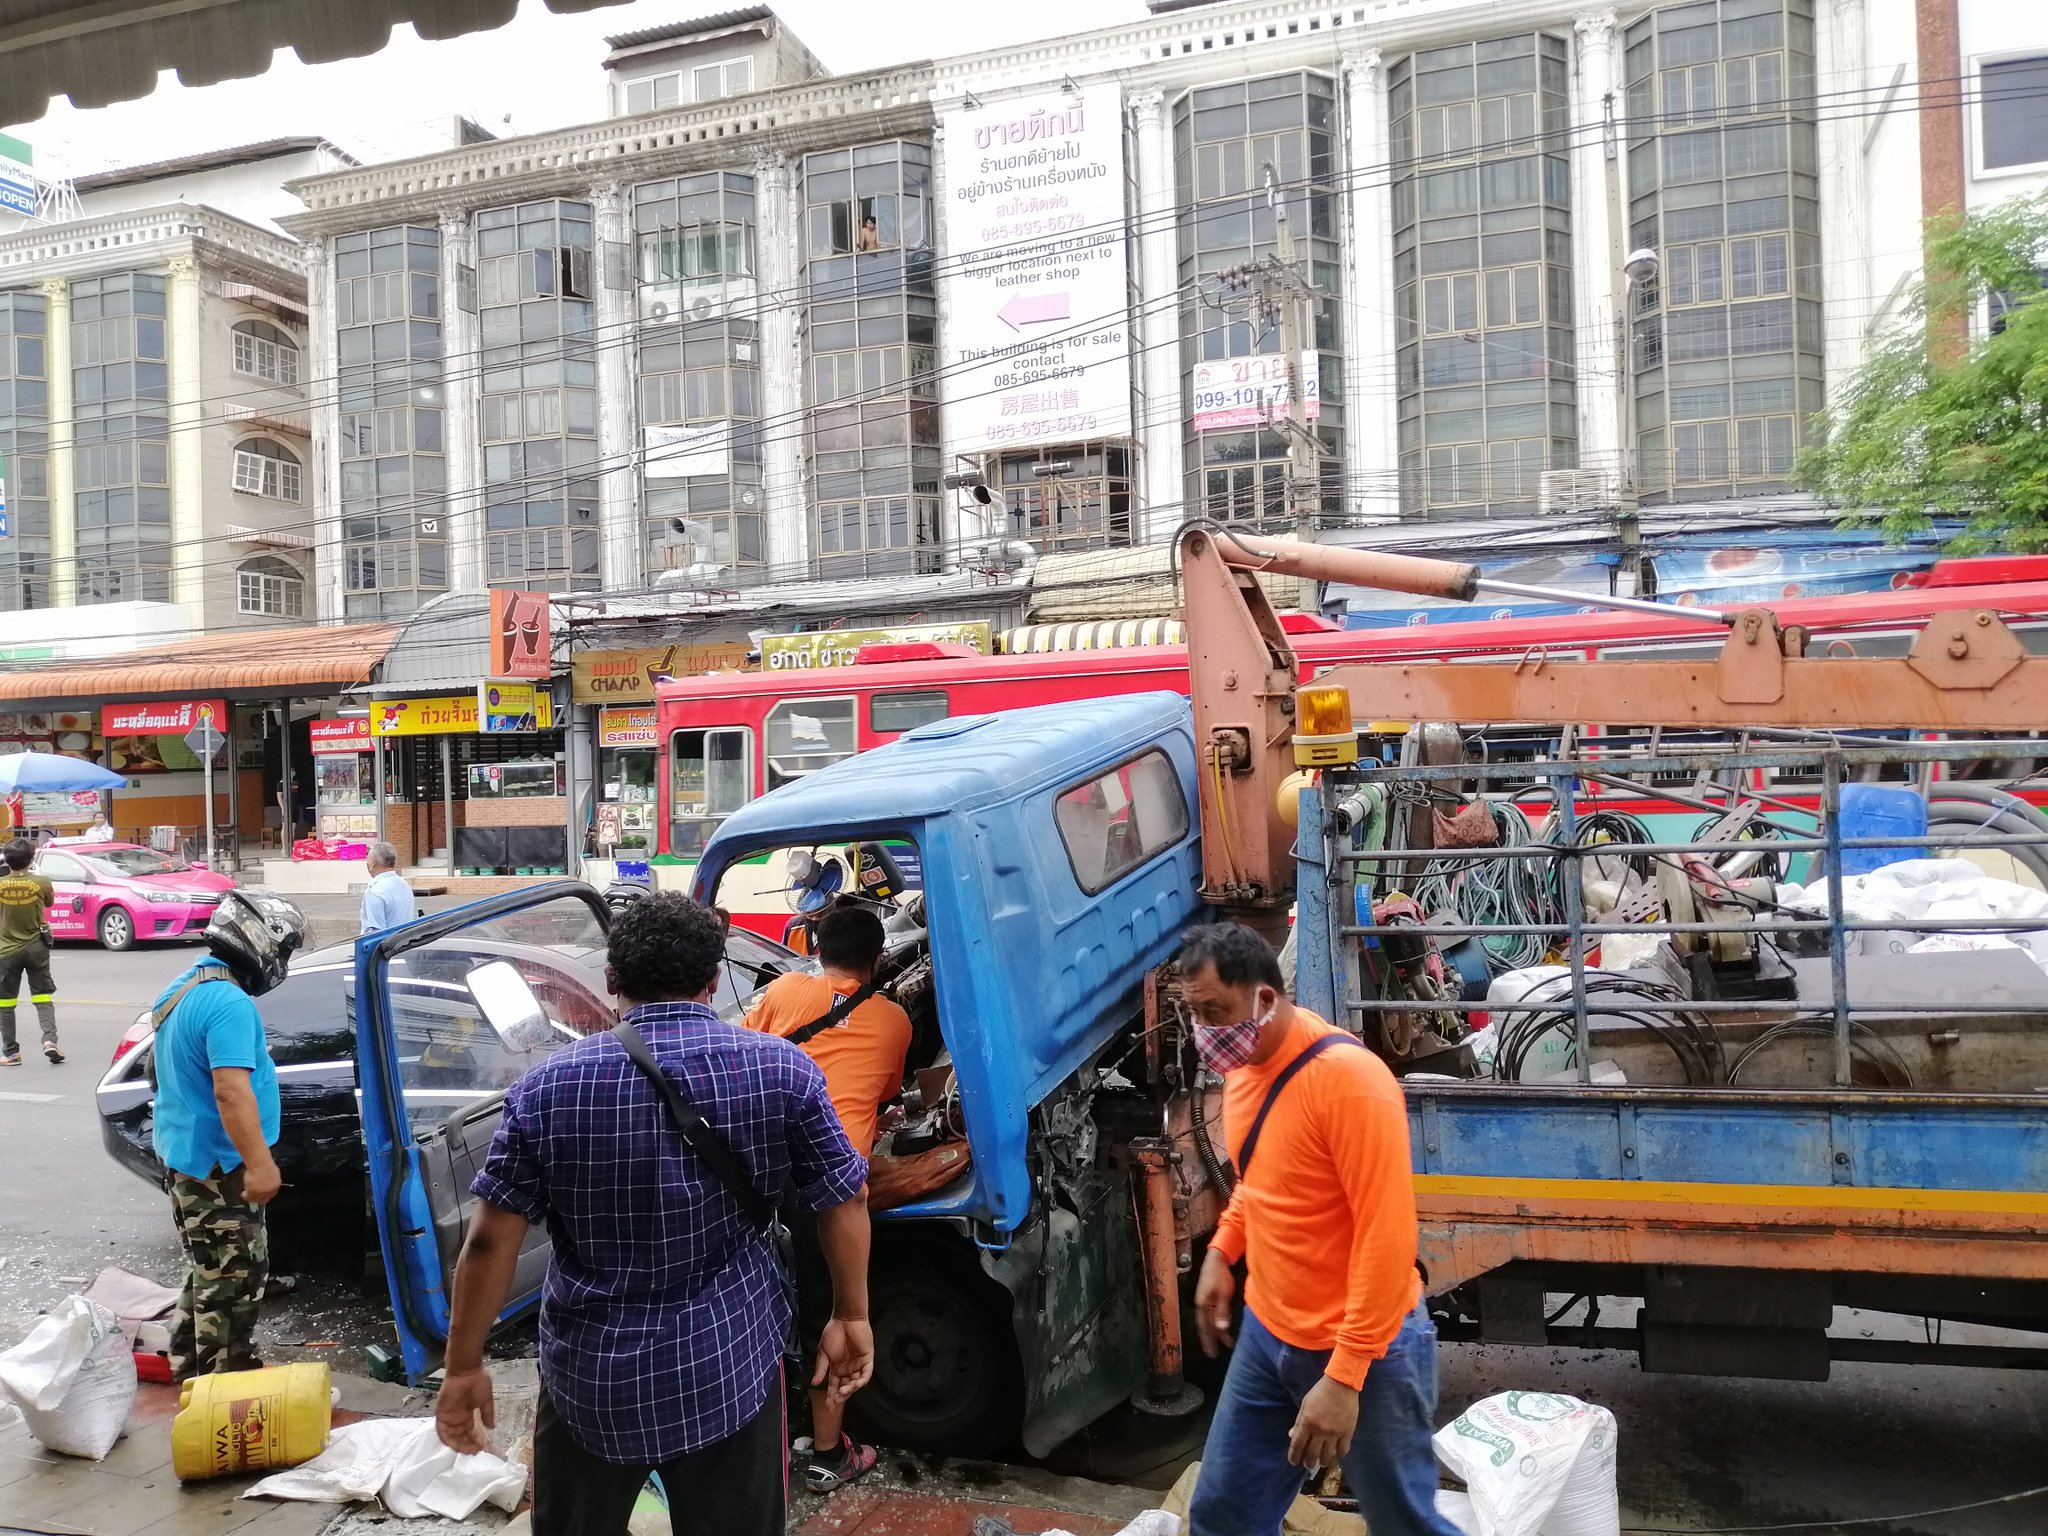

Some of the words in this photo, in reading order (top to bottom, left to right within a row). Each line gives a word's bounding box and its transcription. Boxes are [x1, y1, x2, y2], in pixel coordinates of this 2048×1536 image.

[974, 97, 1085, 149] ขายตึกนี้
[980, 141, 1081, 174] ร้านฮกดีย้ายไป
[0, 162, 33, 182] ilyMart
[957, 162, 1107, 204] อยู่ข้างร้านเครื่องหนัง
[3, 190, 34, 212] OPEN
[996, 193, 1069, 218] สนใจติดต่อ
[959, 254, 979, 265] We
[983, 250, 1003, 262] are
[1006, 241, 1055, 258] moving
[1059, 239, 1072, 250] to
[1076, 237, 1084, 247] a
[1088, 232, 1116, 245] new
[964, 264, 1004, 280] bigger
[1008, 255, 1063, 272] location
[1066, 253, 1095, 264] next
[1099, 248, 1112, 258] to
[995, 272, 1041, 288] leather
[1046, 267, 1080, 281] shop
[959, 348, 987, 363] This
[992, 340, 1047, 357] building
[1052, 337, 1064, 350] is
[1068, 335, 1087, 348] for
[1092, 331, 1121, 345] sale
[1013, 353, 1065, 370] contact
[1231, 357, 1288, 383] ขาย
[994, 365, 1085, 387] 085-695-6679
[1000, 388, 1080, 416] 房屋出售
[769, 640, 811, 669] ฮกดี
[820, 639, 858, 668] ข้าว
[591, 676, 641, 693] CHAMP
[1469, 1425, 1512, 1453] WHEAT
